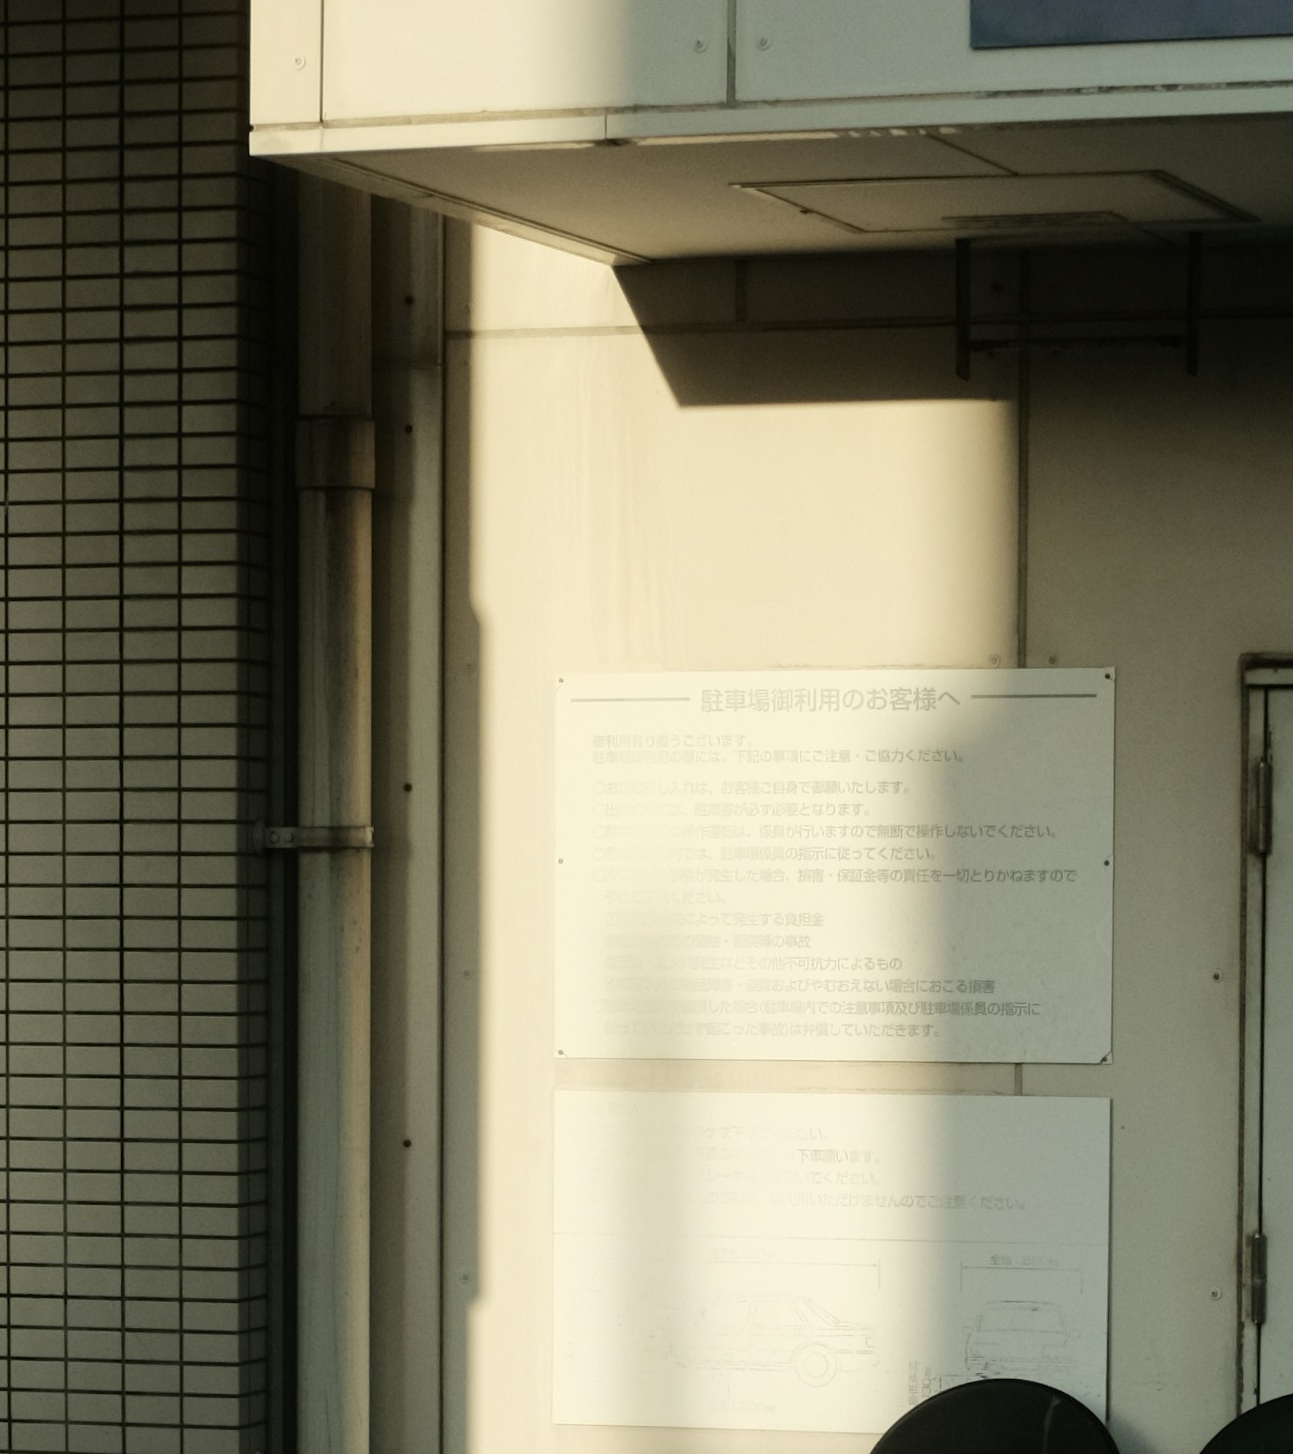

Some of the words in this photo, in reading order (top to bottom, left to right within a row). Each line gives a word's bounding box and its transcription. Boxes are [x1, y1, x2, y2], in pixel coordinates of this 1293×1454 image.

[700, 687, 962, 714] 駐車場御利用のお客様へ
